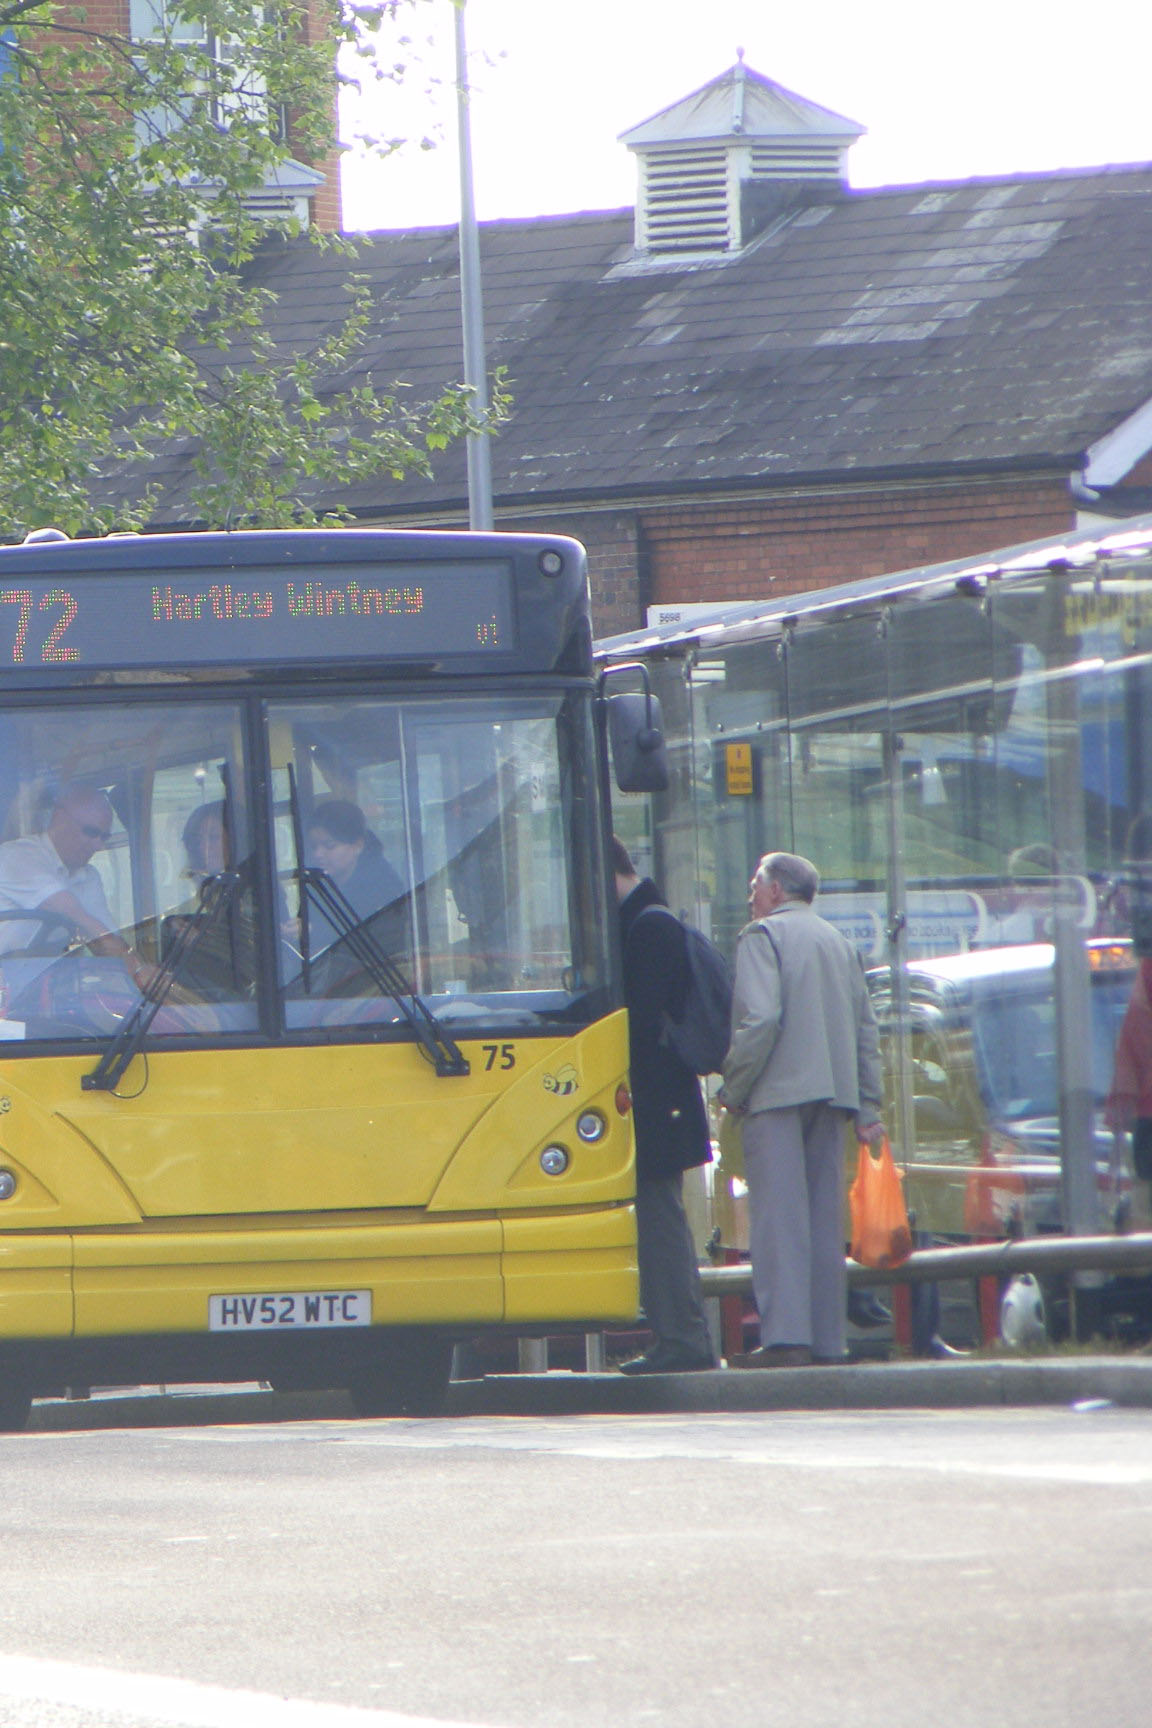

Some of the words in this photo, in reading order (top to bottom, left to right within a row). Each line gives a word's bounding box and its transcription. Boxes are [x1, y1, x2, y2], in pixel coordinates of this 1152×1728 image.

[151, 584, 273, 620] Hartley
[287, 581, 424, 616] Wintney
[482, 1044, 515, 1071] 75
[221, 1297, 296, 1325] HV52
[304, 1295, 359, 1322] WTC
